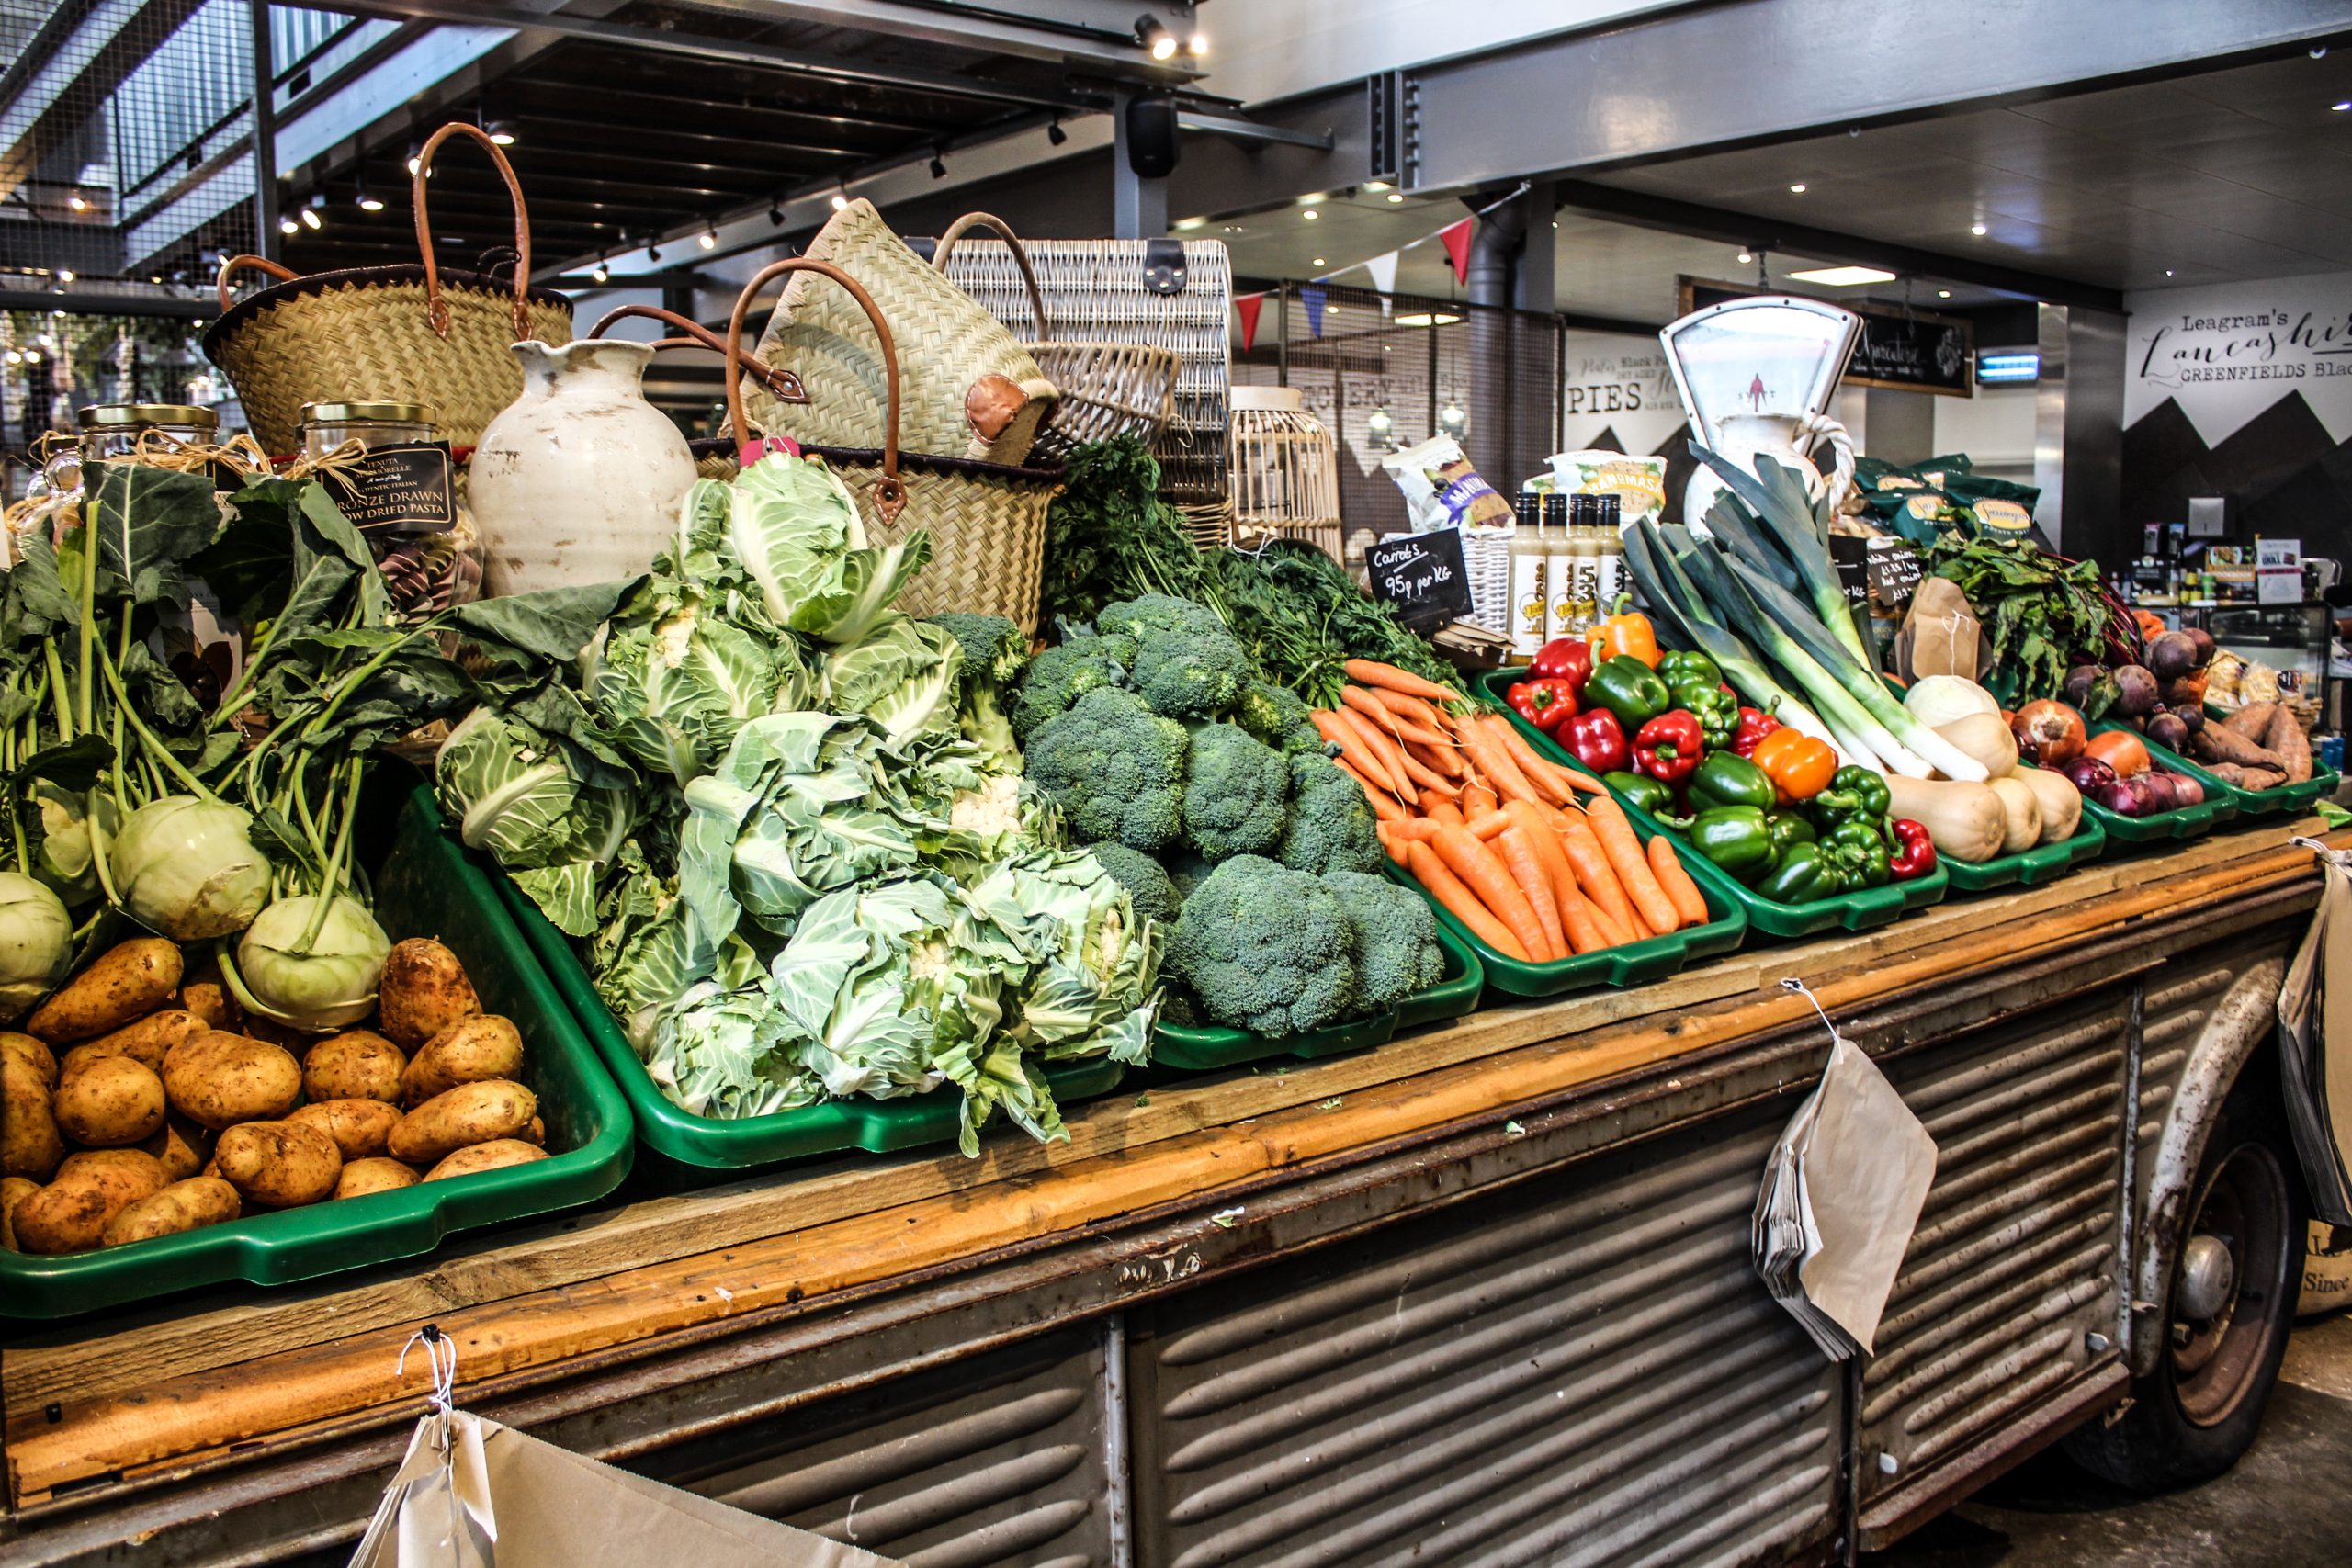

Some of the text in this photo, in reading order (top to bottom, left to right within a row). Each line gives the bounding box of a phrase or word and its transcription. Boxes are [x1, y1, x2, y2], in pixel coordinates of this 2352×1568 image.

[2181, 308, 2289, 333] Leagram's
[2180, 364, 2307, 382] GREENFIELDS
[1567, 382, 1642, 414] PIES
[367, 457, 399, 468] TENUTA
[357, 480, 418, 493] UTHENTIC ITALIAN
[1587, 472, 1663, 495] MANOMASA
[337, 491, 443, 512] RONZE DRAWN
[345, 504, 445, 522] OW DRIED PASTA
[1374, 543, 1420, 567] Carrots
[1385, 574, 1412, 599] 95p
[1417, 575, 1432, 596] per
